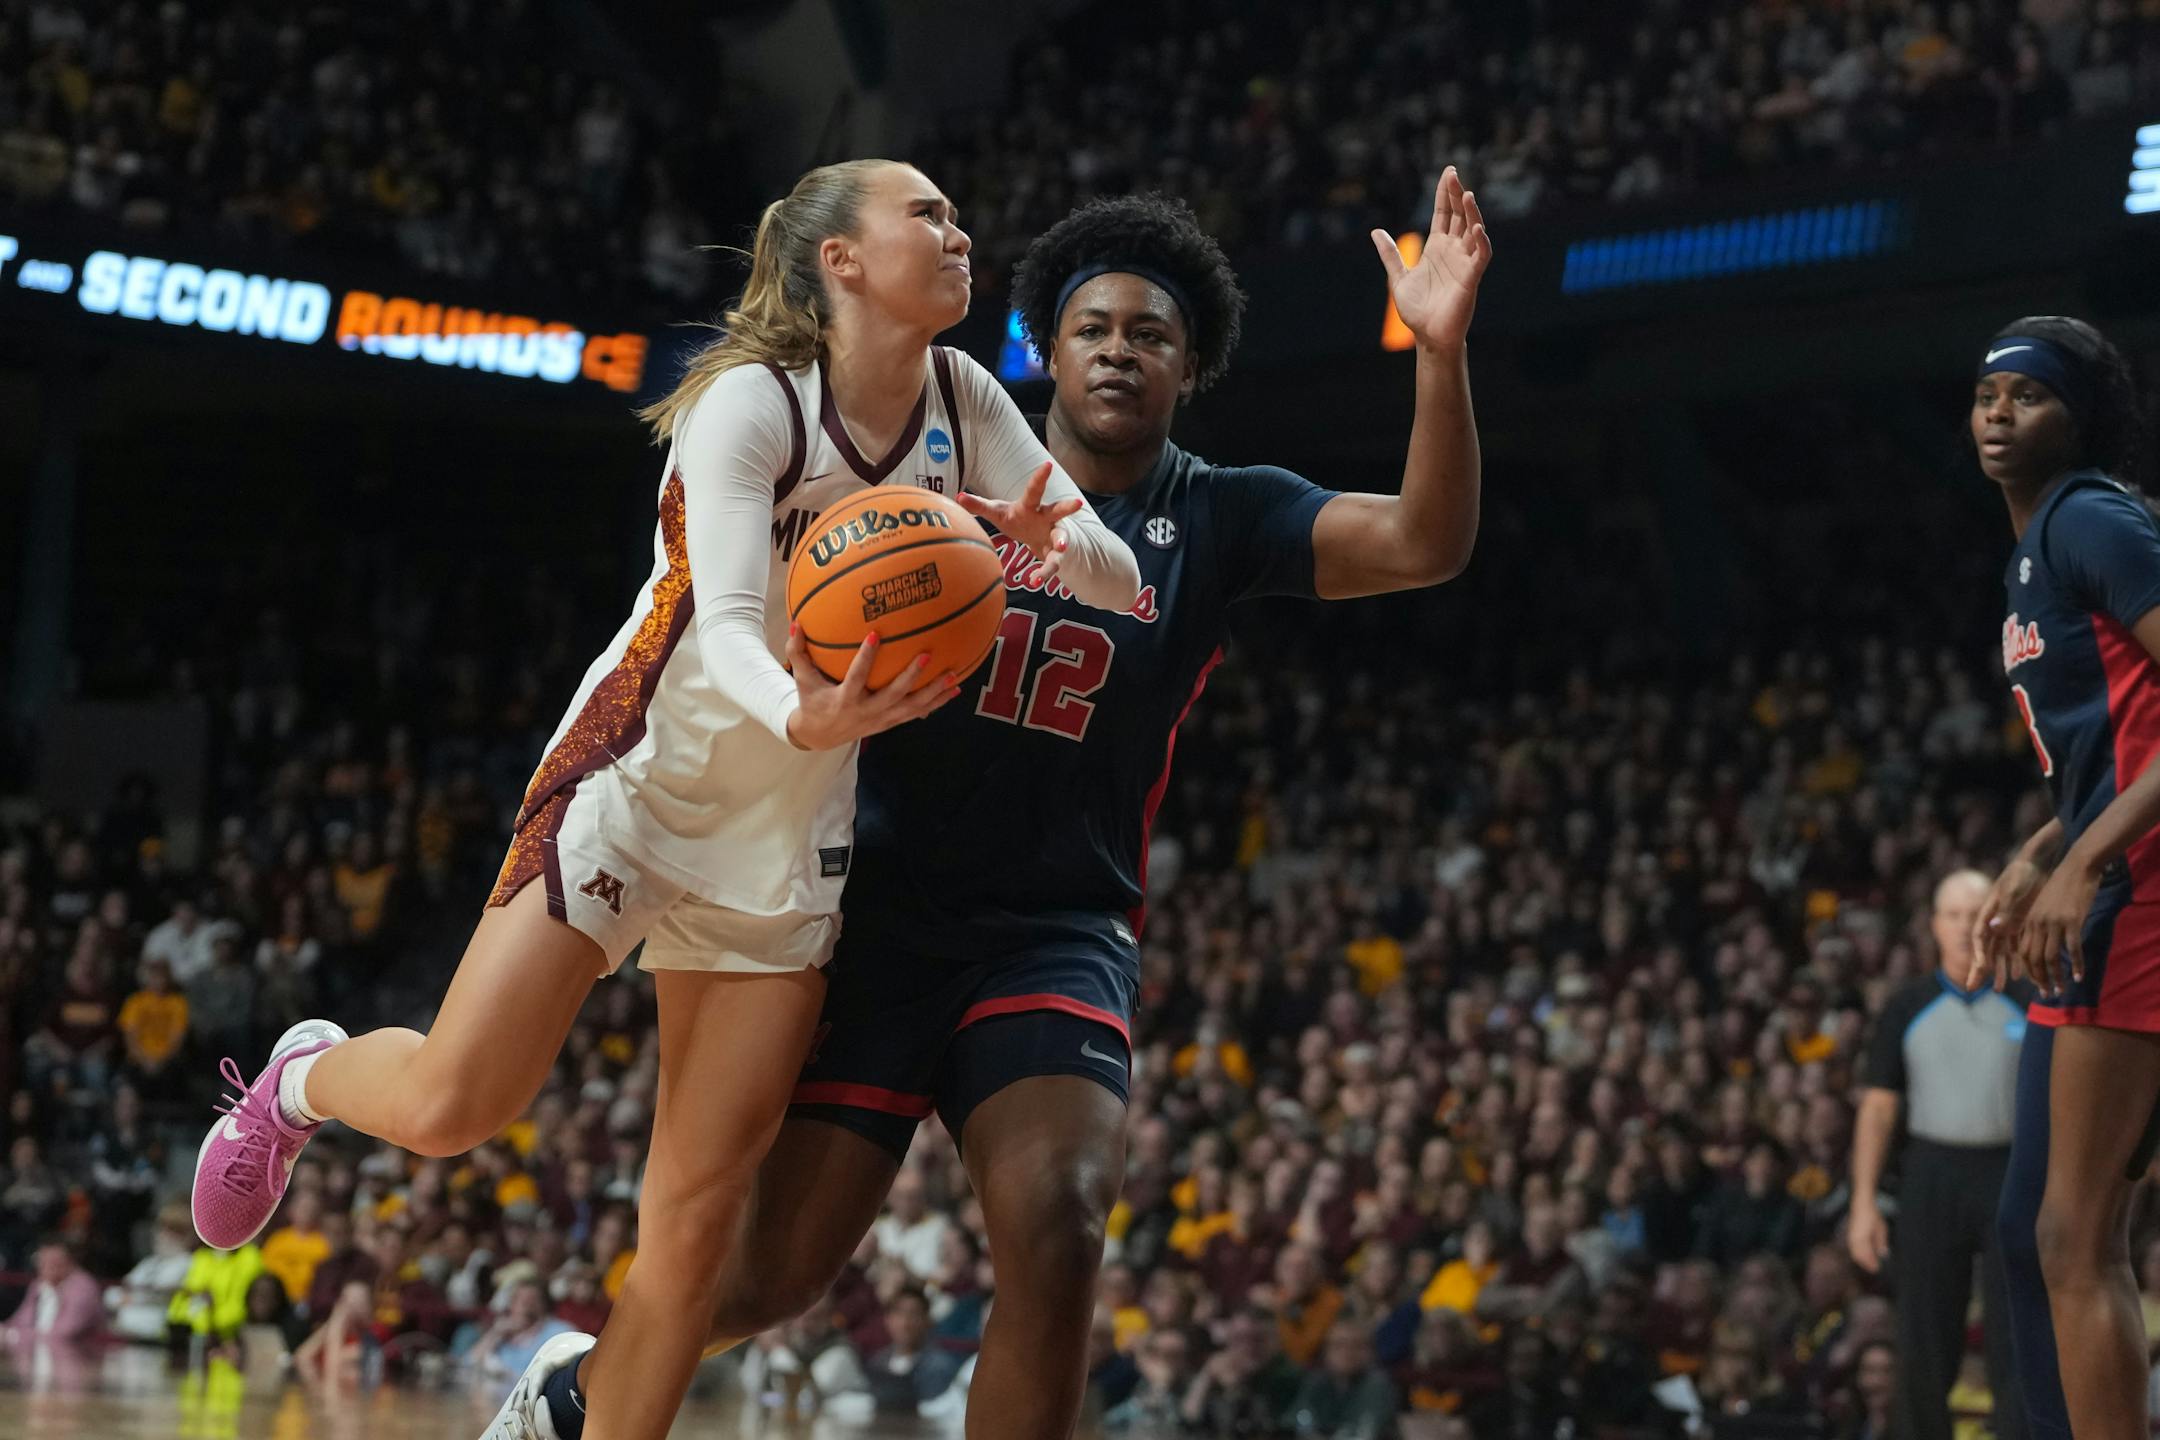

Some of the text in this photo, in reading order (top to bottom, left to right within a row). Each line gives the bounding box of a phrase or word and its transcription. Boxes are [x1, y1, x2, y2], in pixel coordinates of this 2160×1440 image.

[78, 250, 331, 344] SECOND
[336, 290, 585, 383] ROUNDS
[808, 508, 952, 568] Wilson
[1145, 516, 1177, 545] SEC
[875, 571, 919, 596] MARCH
[885, 577, 942, 610] MADNESS
[974, 607, 1115, 743] 12
[576, 865, 625, 919] M
